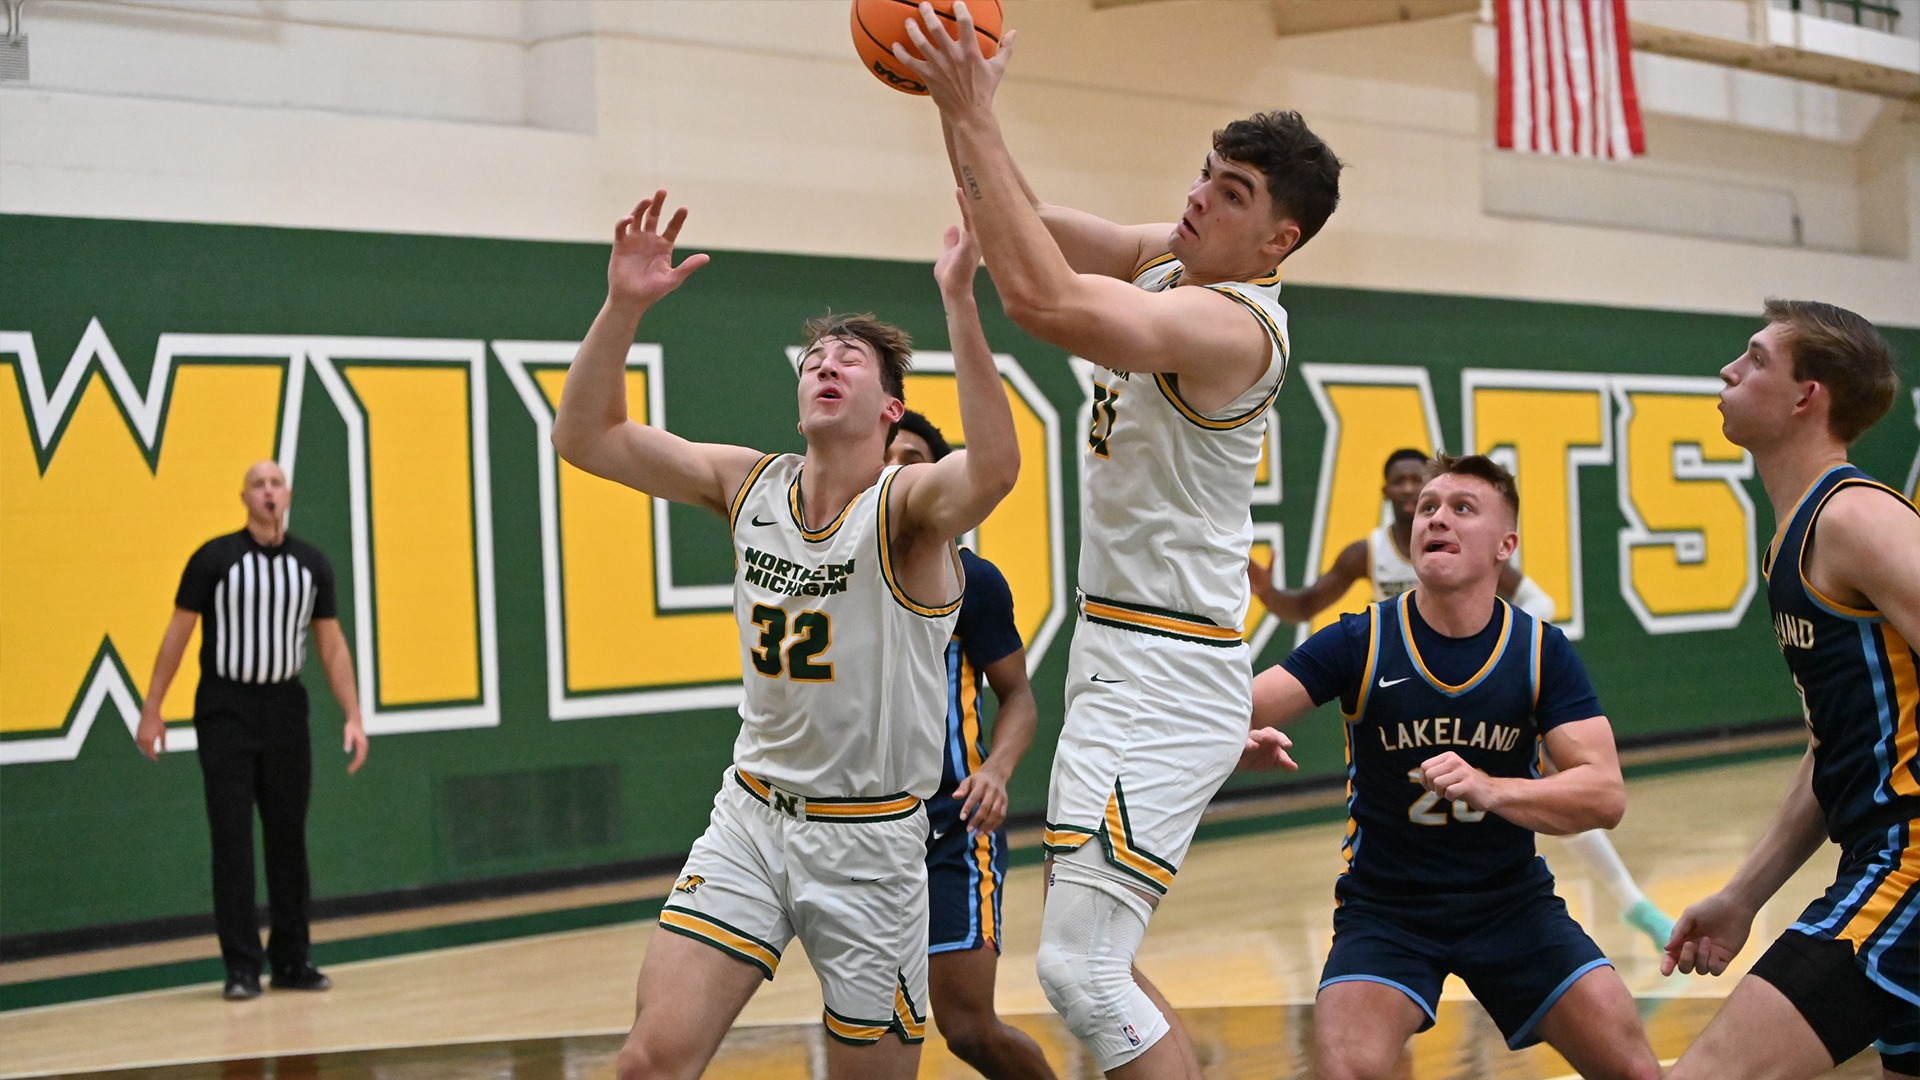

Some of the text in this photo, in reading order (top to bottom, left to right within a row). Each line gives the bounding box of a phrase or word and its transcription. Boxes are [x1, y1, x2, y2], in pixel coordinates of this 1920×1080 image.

[873, 60, 928, 92] CAA
[0, 316, 1759, 765] WILDATS
[744, 546, 856, 582] NORTHERN
[750, 601, 836, 683] 32
[1378, 717, 1521, 752] LAKELAND
[774, 791, 799, 818] N
